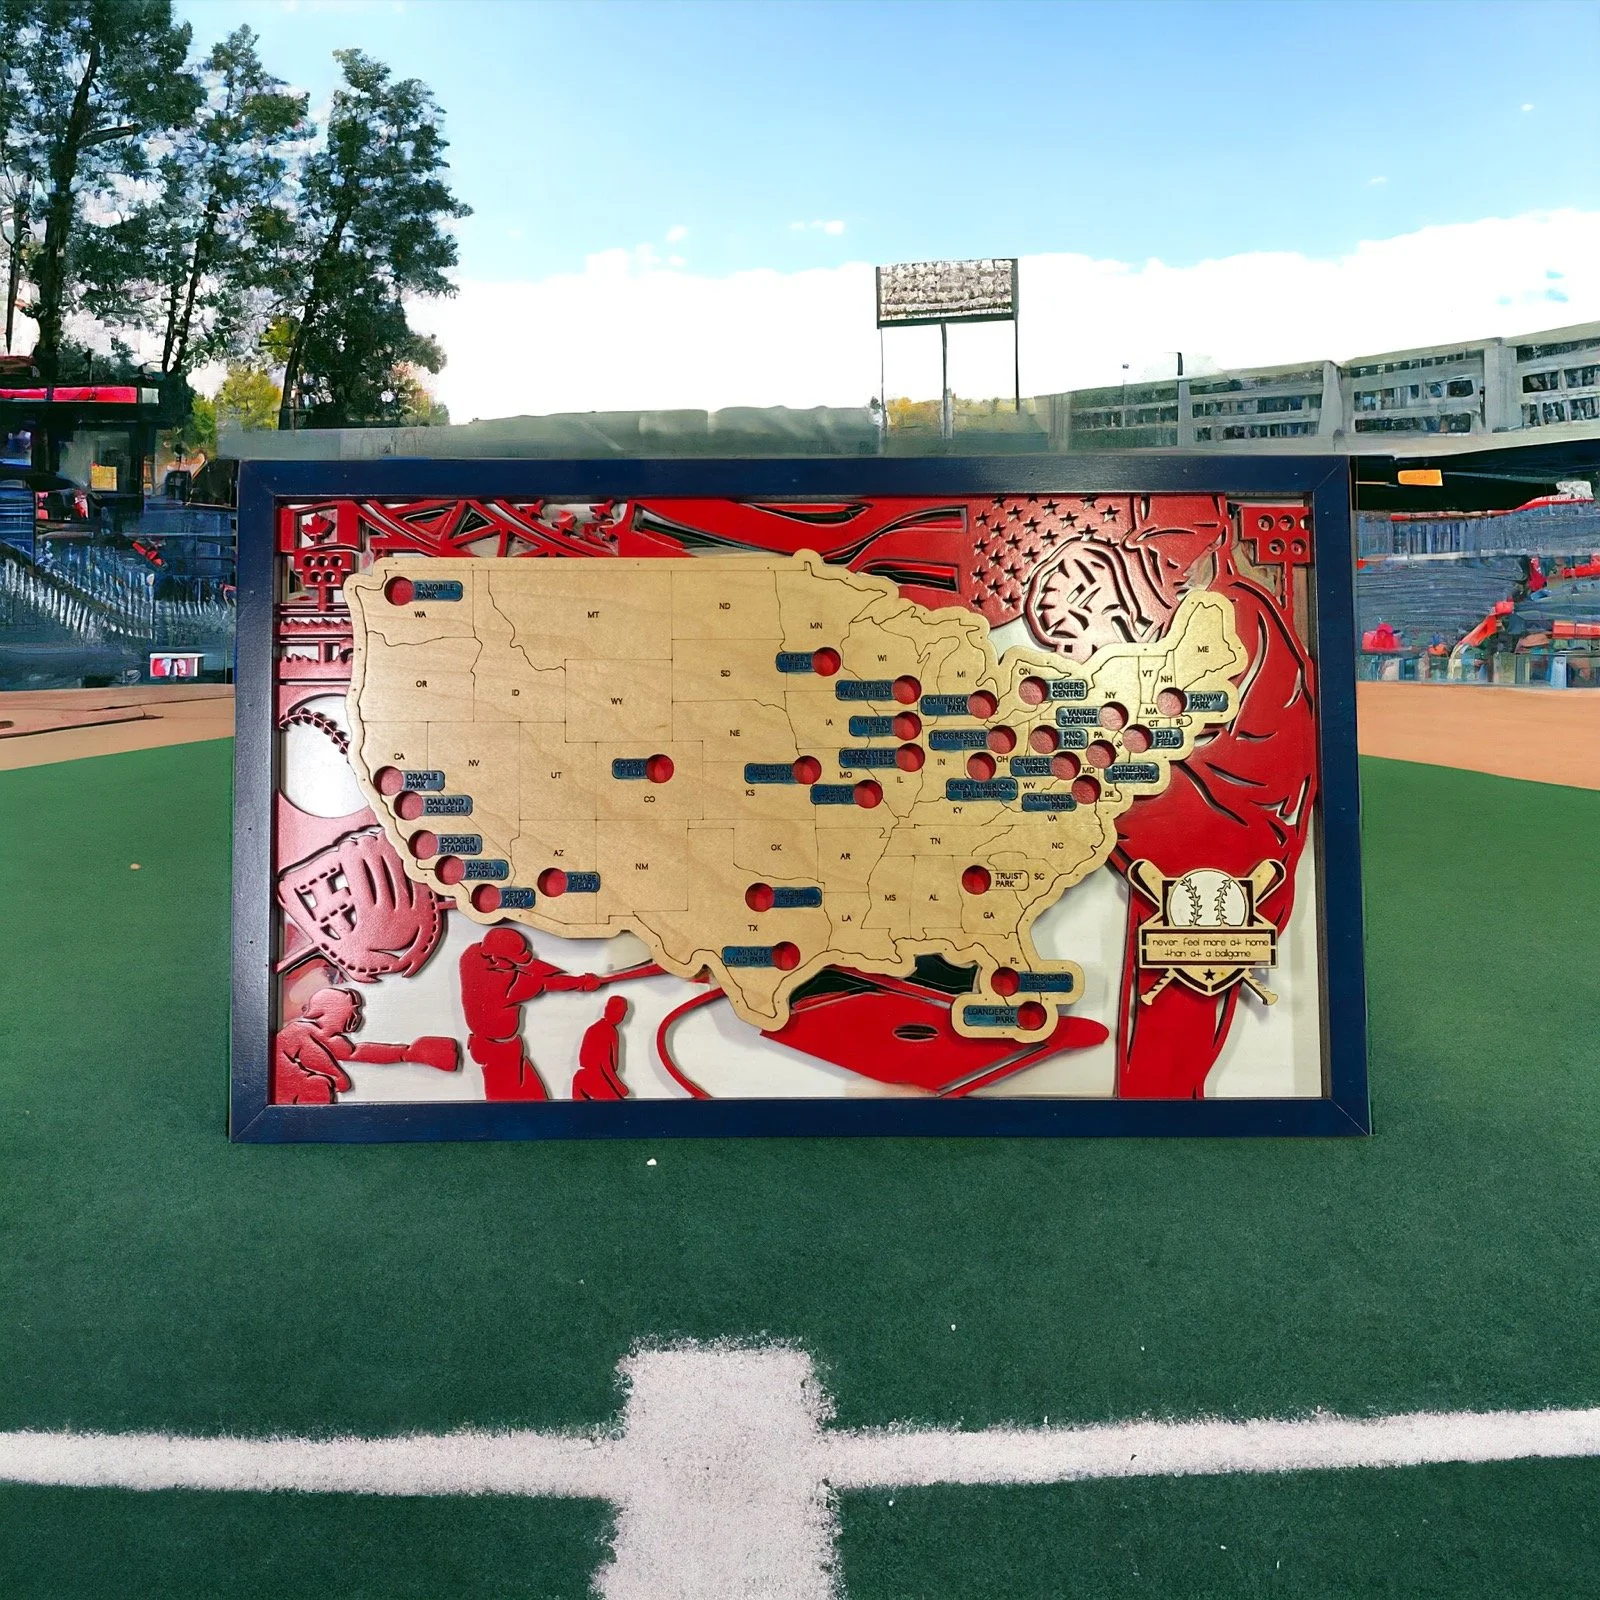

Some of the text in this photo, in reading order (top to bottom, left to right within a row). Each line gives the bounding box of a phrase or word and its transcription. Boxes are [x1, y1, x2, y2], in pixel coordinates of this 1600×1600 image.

[417, 591, 437, 599] PARK
[587, 611, 600, 619] MT
[810, 622, 823, 630] MN
[1018, 667, 1031, 675] ON
[1142, 670, 1154, 678] VT
[1160, 675, 1173, 683] NH
[416, 680, 428, 688] OR
[1052, 682, 1084, 690] ROGERS
[1052, 690, 1084, 698] CENTRE
[1105, 691, 1117, 699] NY
[947, 705, 968, 713] PARK
[1190, 701, 1211, 709] PARK
[1067, 708, 1098, 716] YANKEE
[1145, 707, 1158, 715] MA
[1061, 716, 1098, 724] STADIUM
[729, 729, 741, 737] NE
[932, 733, 986, 741] PROGRESSIVE
[1063, 731, 1081, 739] PNC
[1093, 731, 1104, 739] PA
[1063, 739, 1084, 747] PARK
[1155, 738, 1180, 746] FIELD
[468, 759, 480, 767] NV
[937, 758, 946, 766] IN
[1015, 757, 1049, 766] CAMDEN
[1024, 765, 1050, 774] YARDS
[1112, 765, 1150, 773] CITIZENS
[406, 773, 438, 781] ORACLE
[551, 771, 562, 779] UT
[839, 771, 852, 779] MO
[1133, 772, 1155, 780] PARK
[406, 781, 426, 789] PARK
[643, 795, 656, 803] CO
[962, 791, 981, 799] BALL
[1026, 794, 1072, 802] NATIONALS
[426, 798, 465, 806] OAKLAND
[1051, 801, 1071, 809] PARK
[426, 806, 469, 814] COLISEUM
[441, 837, 476, 845] DODGER
[441, 845, 478, 853] STADIUM
[1051, 842, 1064, 850] NC
[553, 849, 564, 857] AZ
[468, 862, 494, 870] ANGEL
[635, 863, 649, 871] NM
[468, 870, 505, 878] STADIUM
[995, 872, 1023, 880] TRUIST
[1034, 872, 1045, 880] SC
[995, 880, 1015, 888] PARK
[841, 914, 852, 922] LA
[983, 912, 995, 920] GA
[748, 924, 758, 932] TX
[1152, 939, 1179, 947] never
[1182, 937, 1200, 946] feel
[1203, 939, 1227, 947] more
[1230, 938, 1241, 947] at
[1245, 938, 1269, 947] home
[1164, 949, 1187, 957] than
[1190, 949, 1201, 957] at
[1215, 949, 1252, 960] ballgame
[967, 1008, 1015, 1016] LOANDEPOT
[995, 1016, 1016, 1024] PARK
